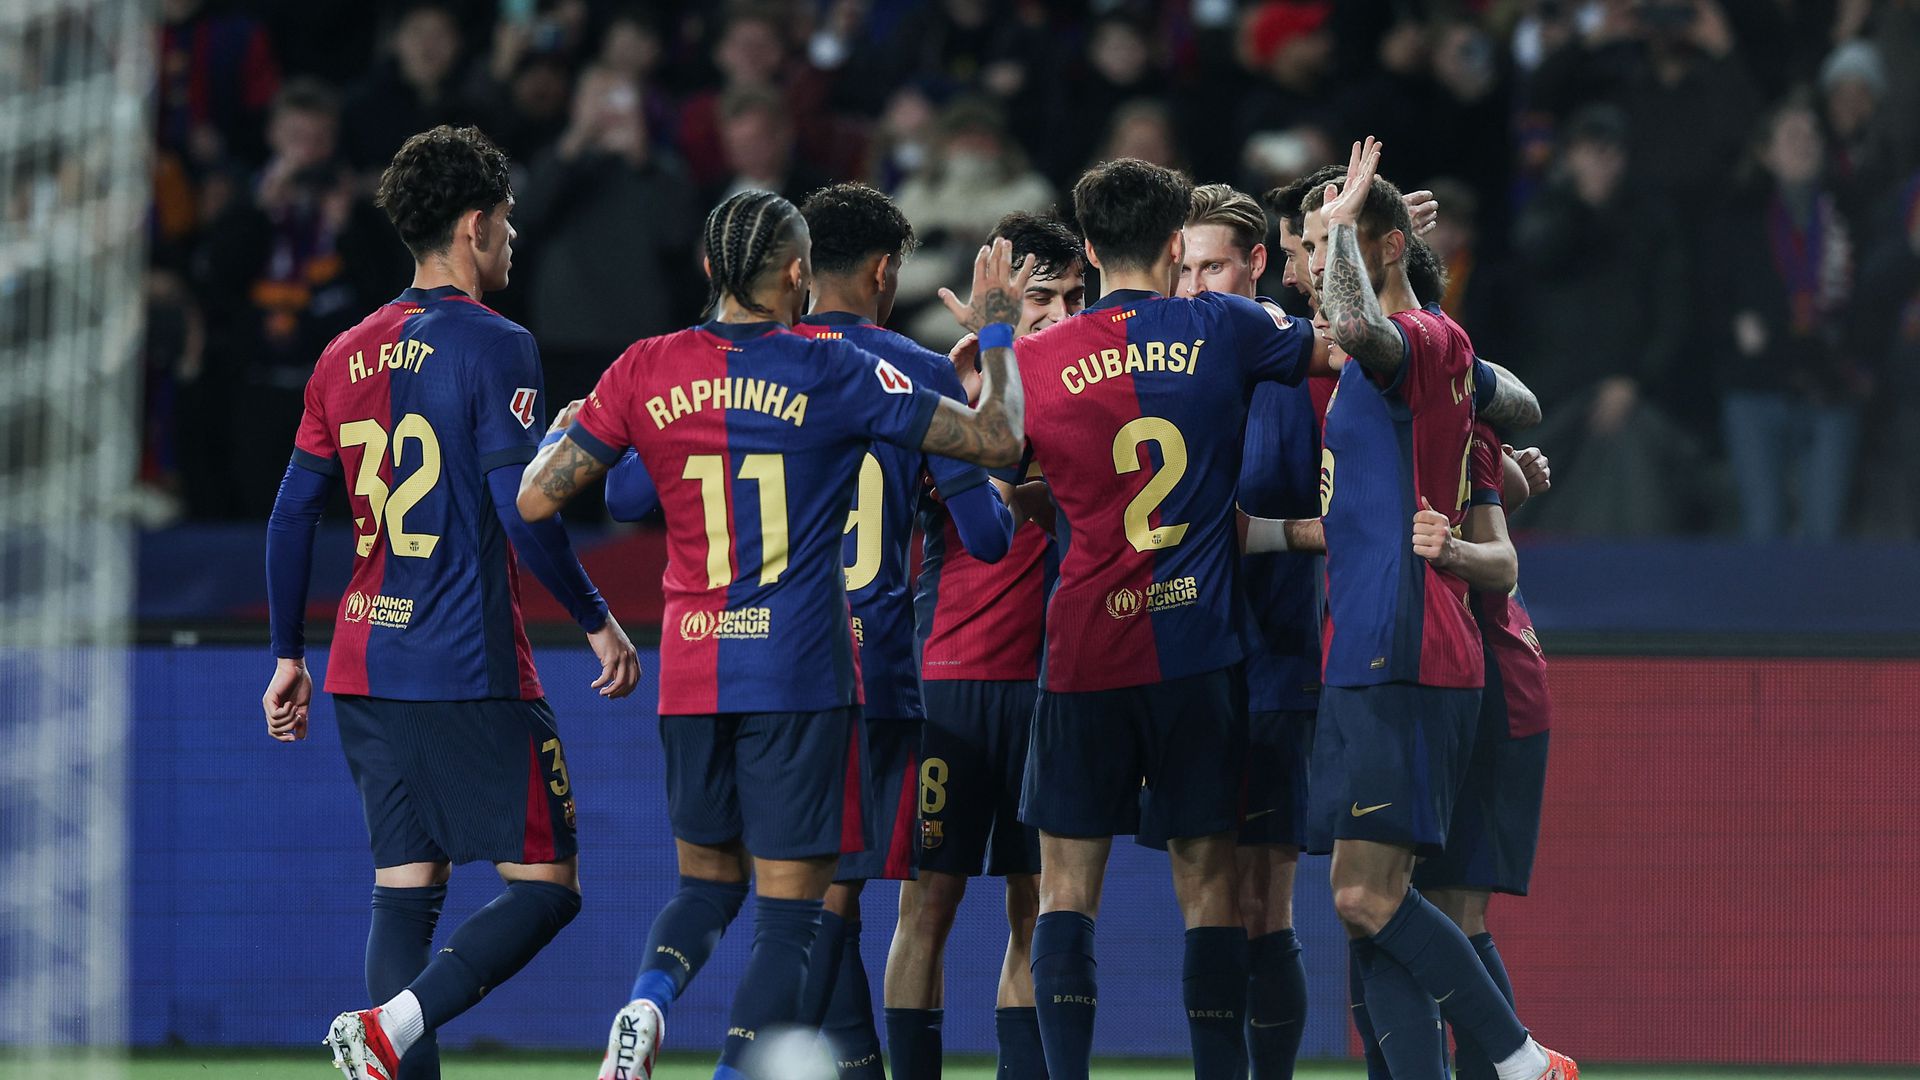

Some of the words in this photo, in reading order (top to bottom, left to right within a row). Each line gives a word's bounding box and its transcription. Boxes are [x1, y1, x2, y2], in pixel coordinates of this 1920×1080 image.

[349, 350, 374, 384] H.
[377, 339, 434, 374] FORT
[1061, 339, 1205, 395] CUBARSÍ
[645, 377, 809, 430] RAPHINHA
[340, 413, 441, 559] 32
[1112, 416, 1190, 553] 2
[682, 453, 789, 590] 11
[372, 595, 413, 611] UNHCR
[1145, 576, 1197, 596] UNHCR
[1145, 588, 1198, 608] ACNUR
[368, 608, 411, 623] ACNUR
[713, 621, 770, 634] ACNUR
[718, 607, 770, 623] UNHCR
[542, 738, 569, 796] 3
[921, 757, 949, 813] 8
